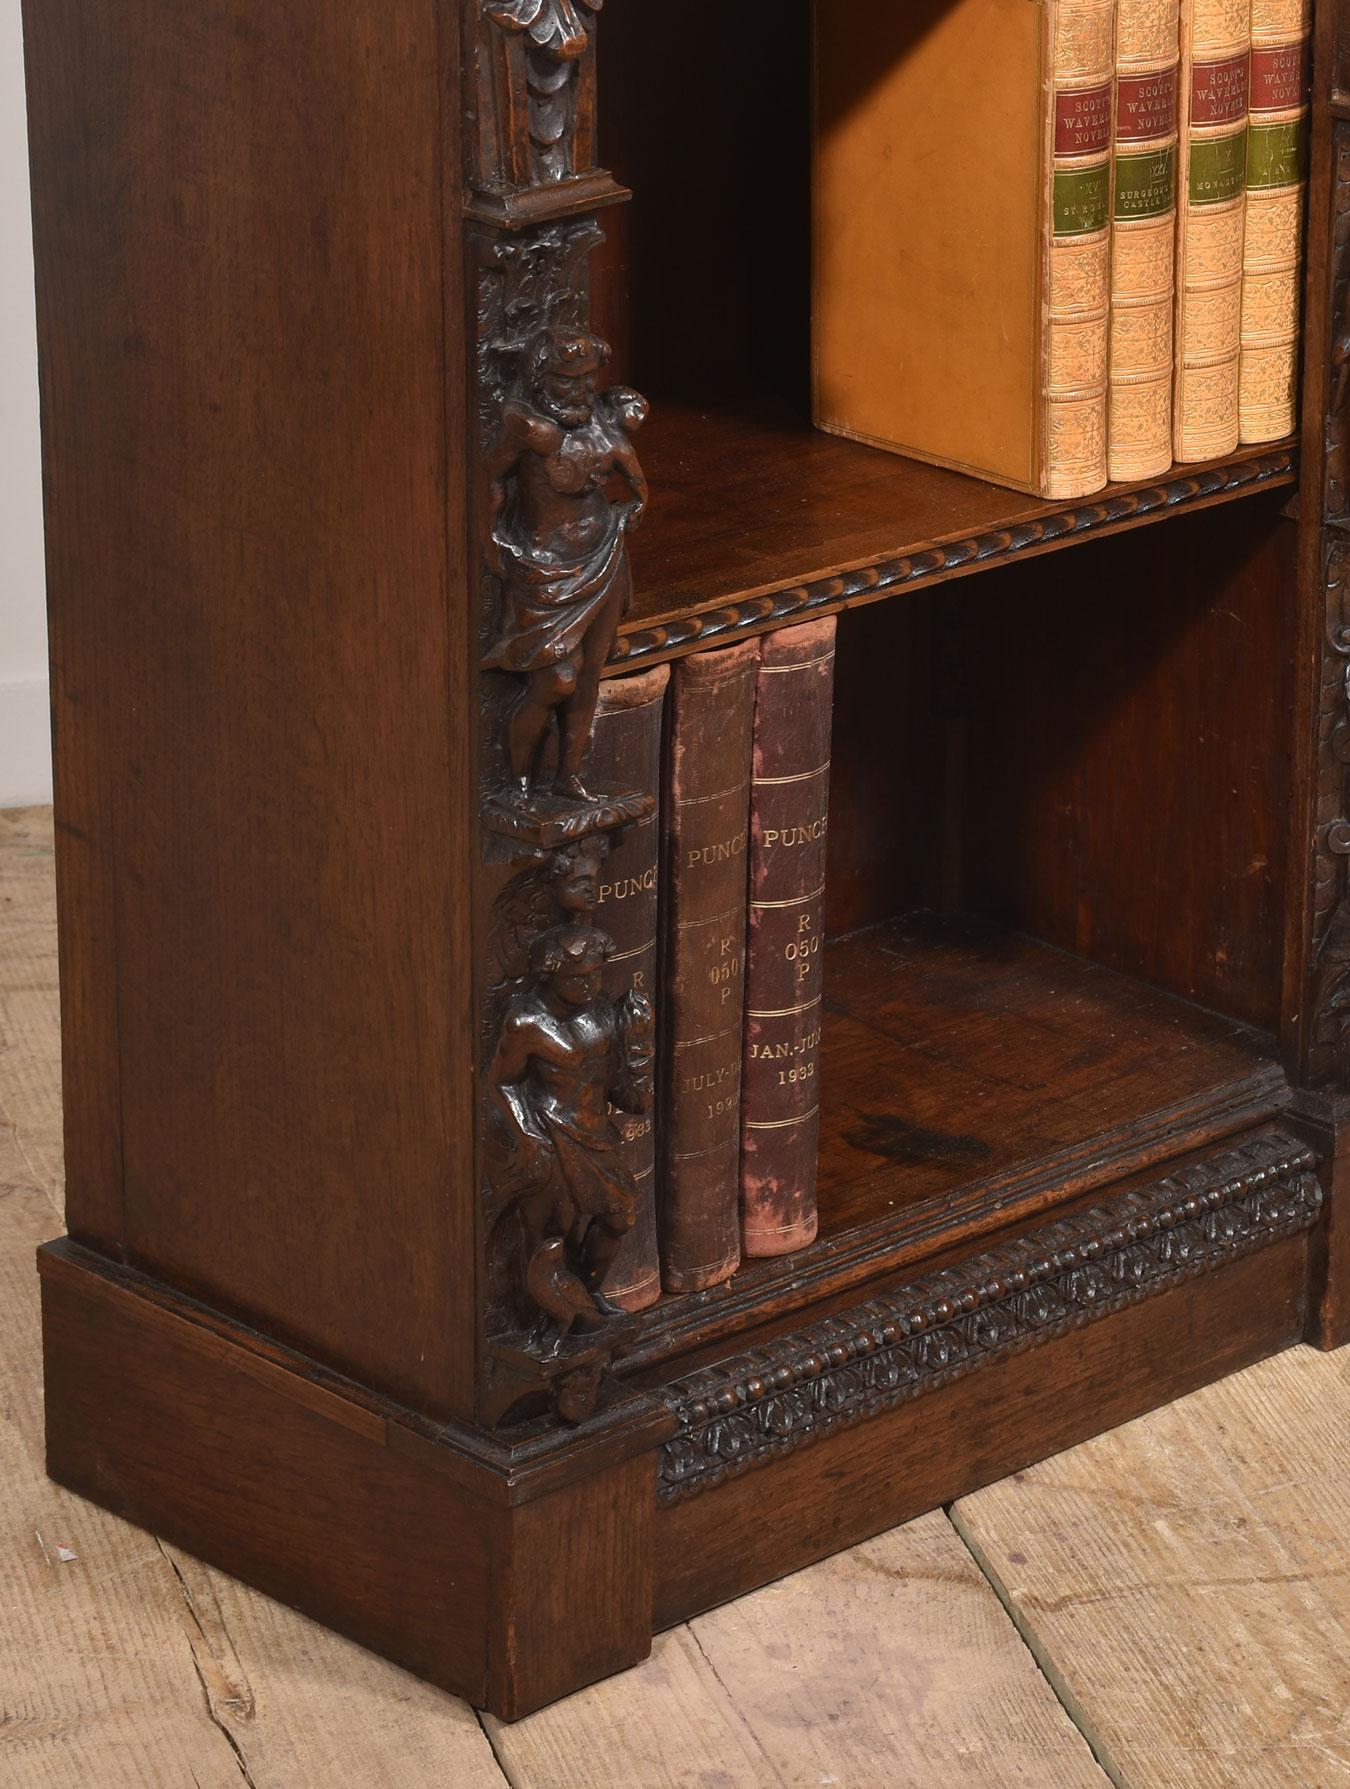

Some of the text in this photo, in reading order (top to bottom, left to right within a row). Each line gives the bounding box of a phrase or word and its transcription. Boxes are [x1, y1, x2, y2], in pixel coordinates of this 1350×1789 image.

[797, 914, 811, 933] R
[720, 939, 732, 956] R
[785, 936, 819, 961] 050
[632, 972, 645, 987] R
[798, 962, 810, 981] P
[721, 986, 731, 1005] P
[778, 1062, 814, 1085] 1933
